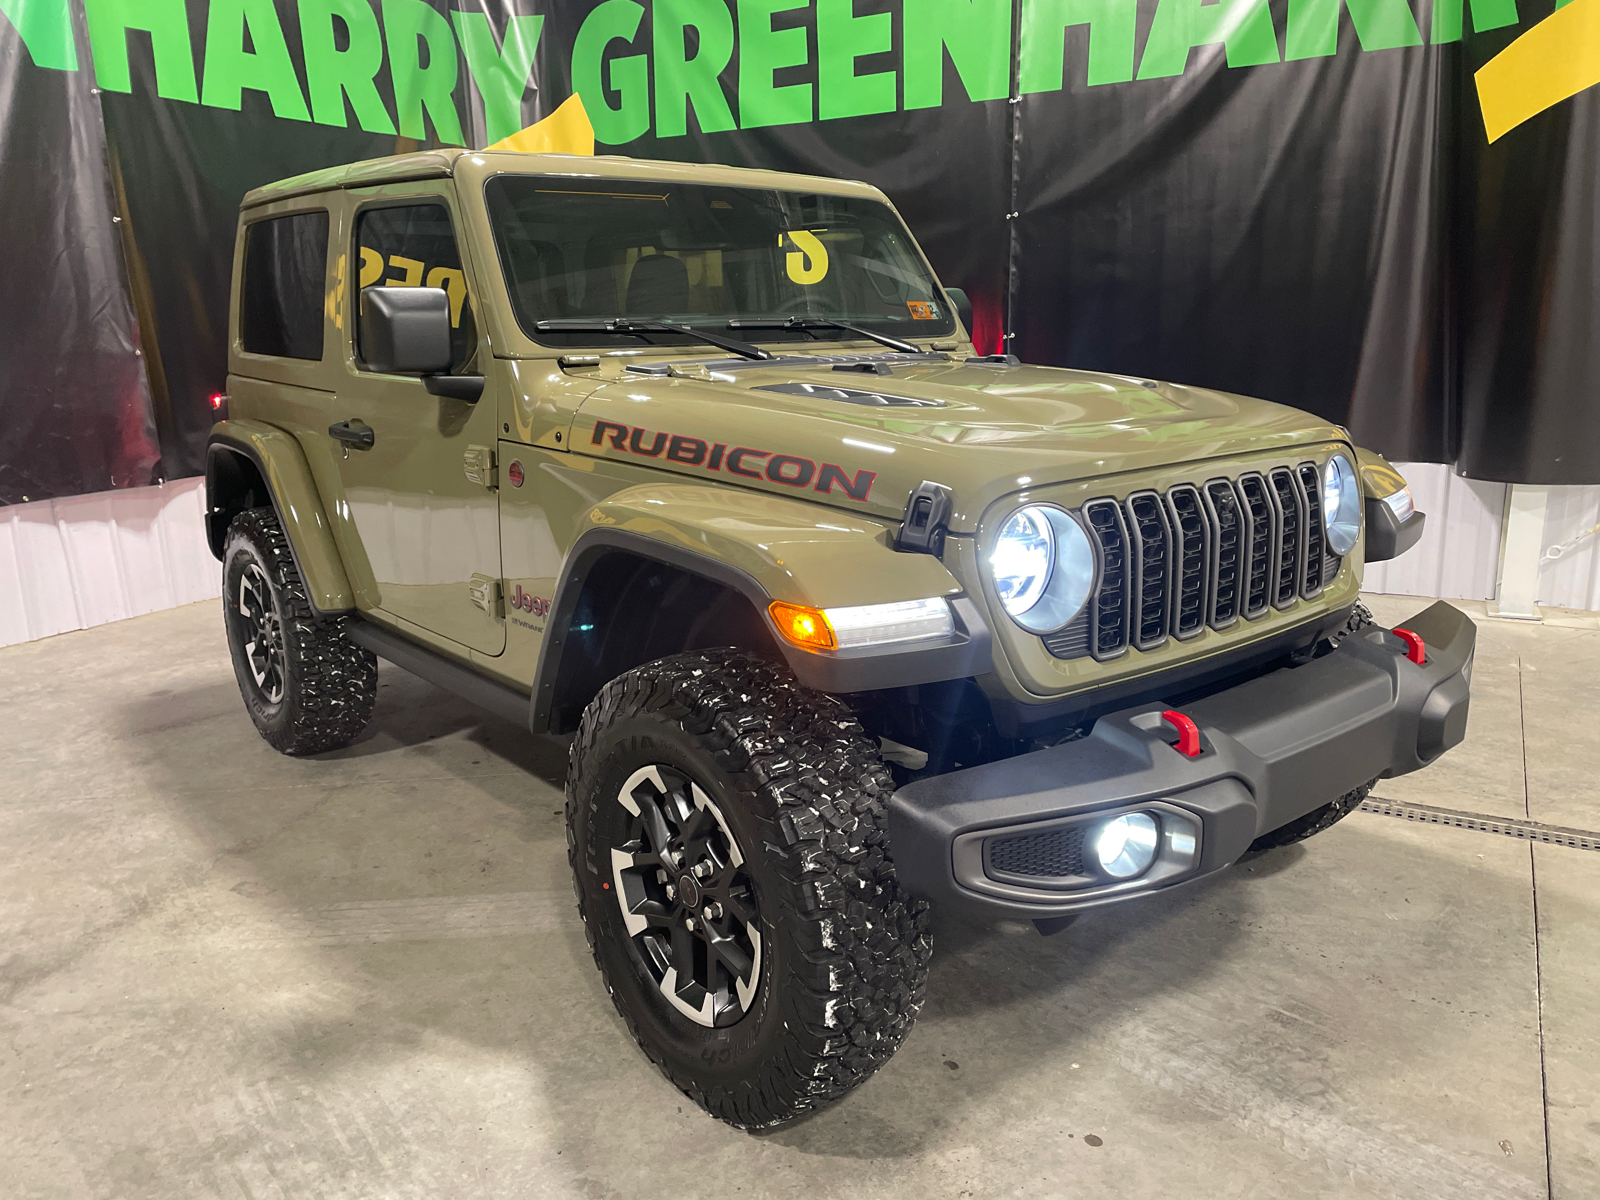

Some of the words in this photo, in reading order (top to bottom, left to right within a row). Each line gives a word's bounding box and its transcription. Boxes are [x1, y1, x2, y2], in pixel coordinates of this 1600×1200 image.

[84, 0, 545, 148] HARRY
[571, 0, 1012, 145] GREEN
[590, 420, 877, 502] RUBICON
